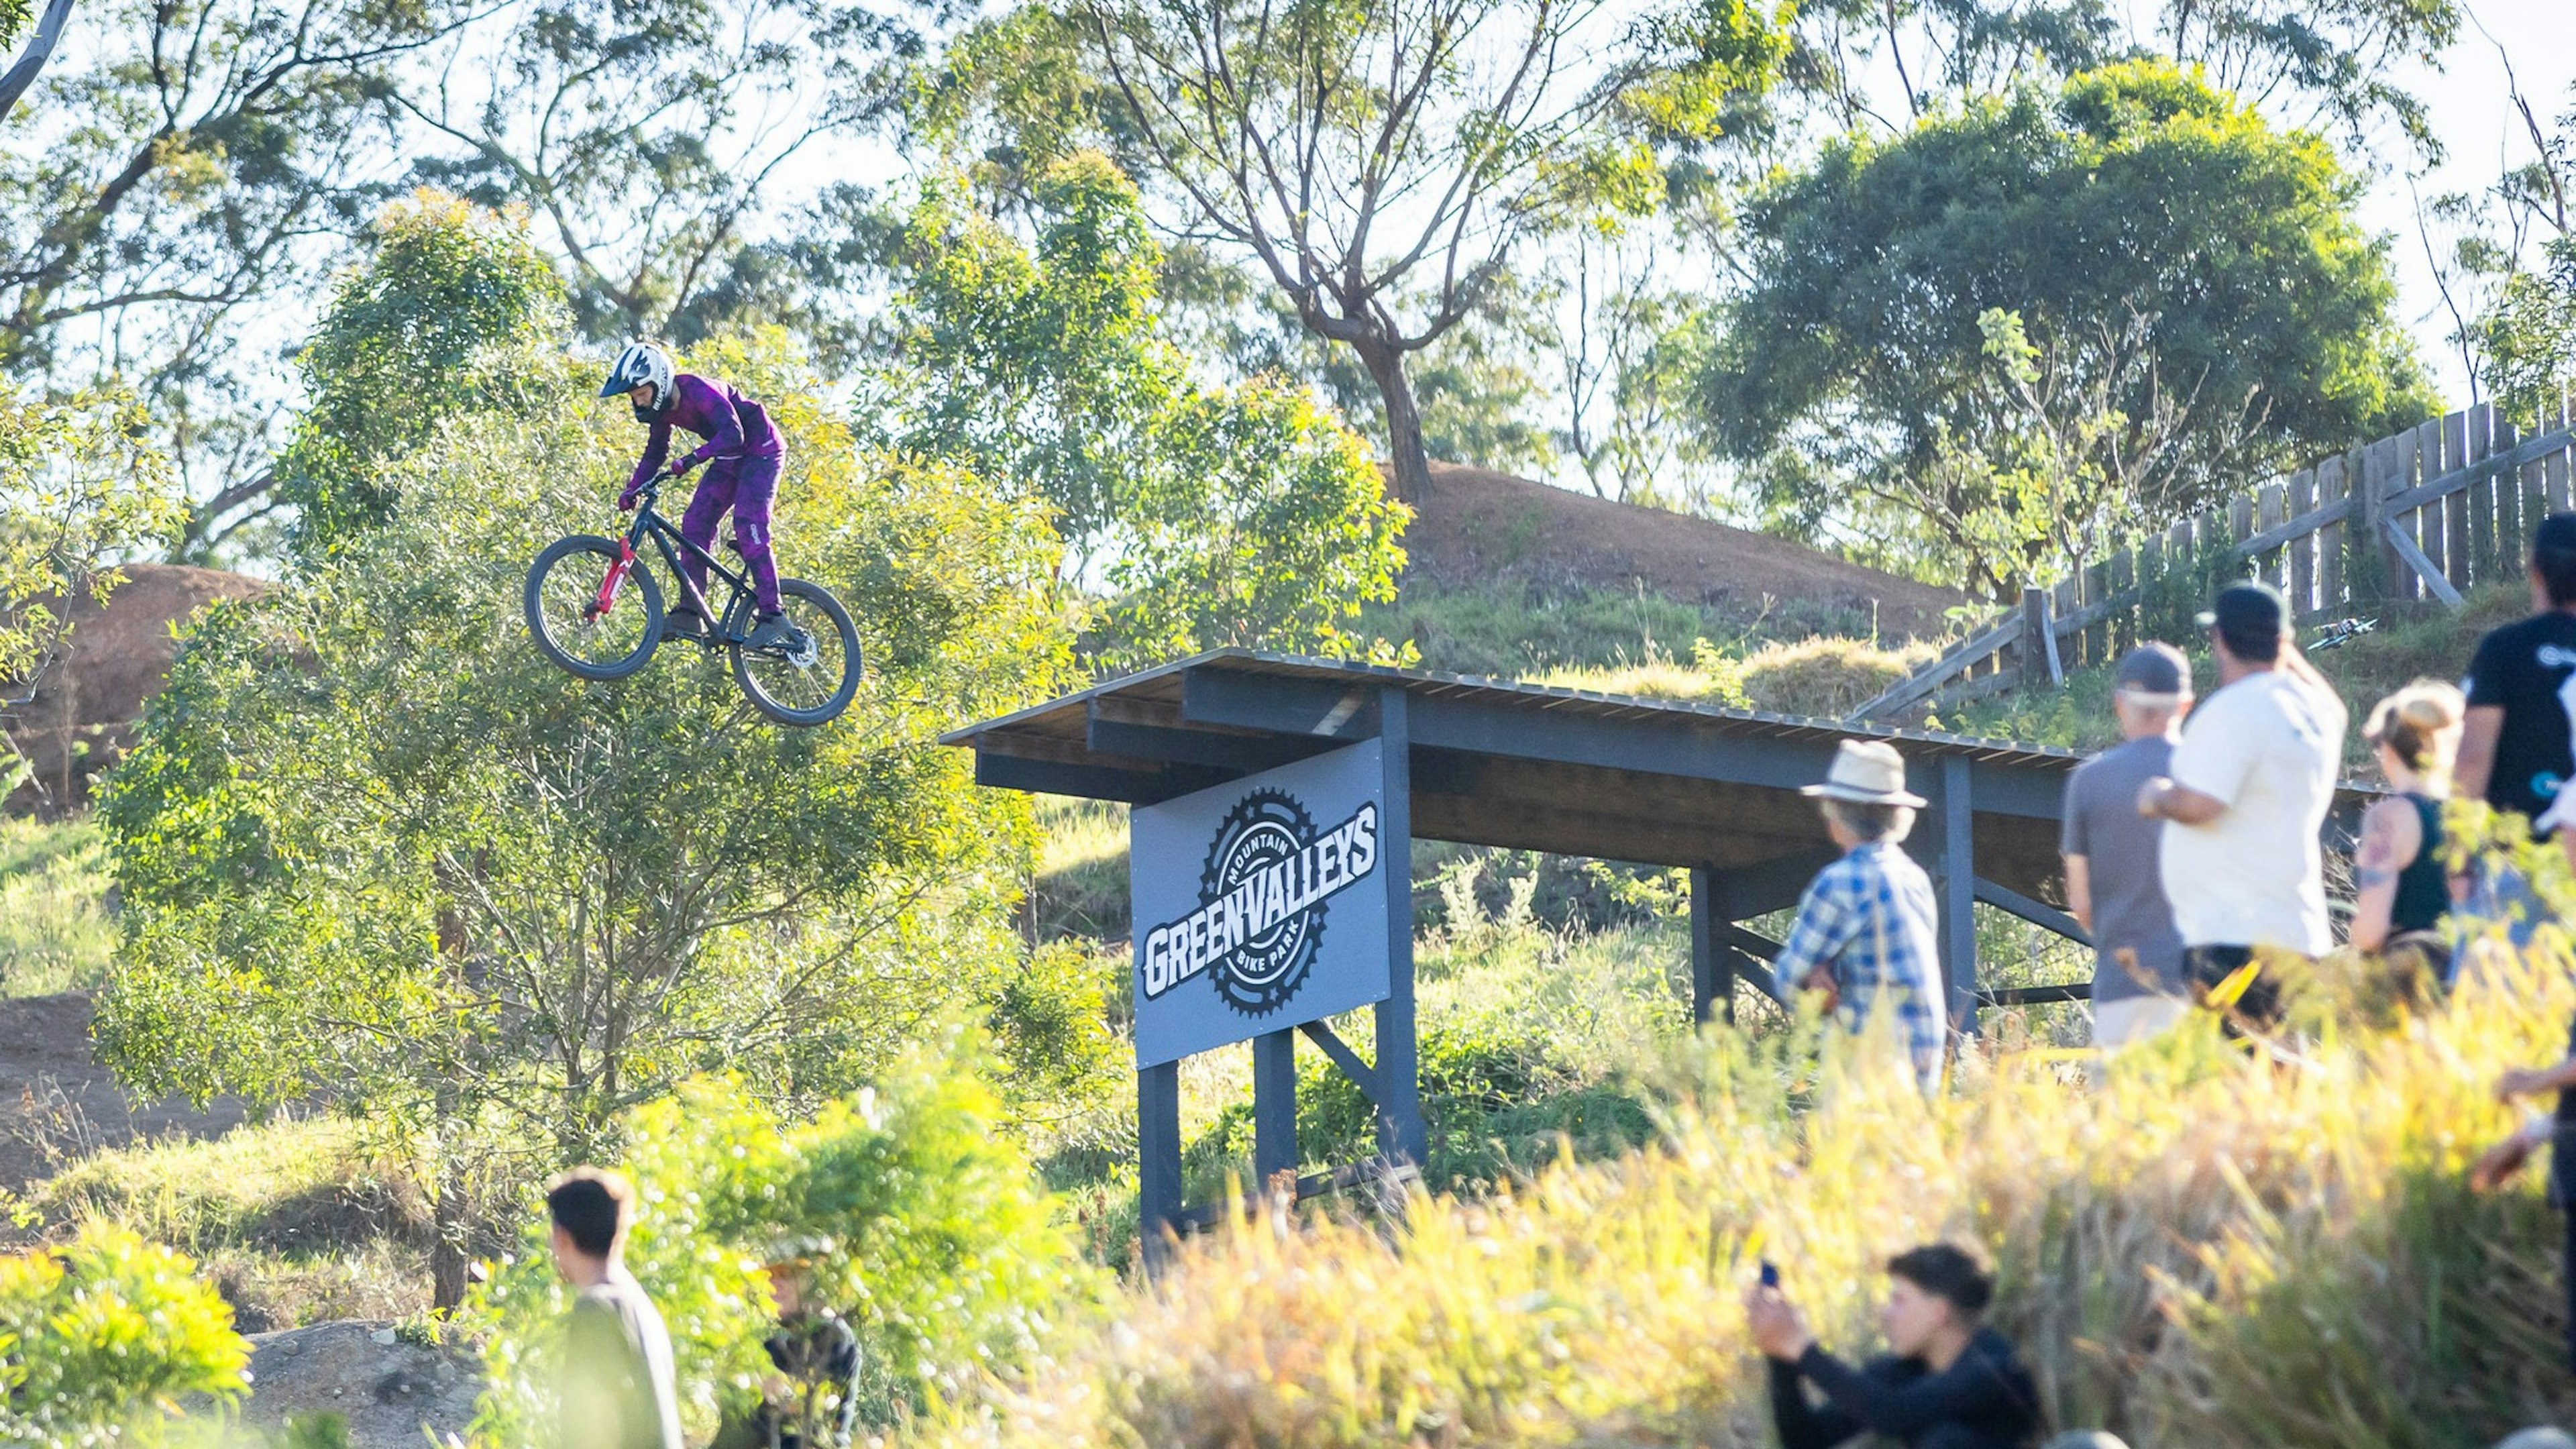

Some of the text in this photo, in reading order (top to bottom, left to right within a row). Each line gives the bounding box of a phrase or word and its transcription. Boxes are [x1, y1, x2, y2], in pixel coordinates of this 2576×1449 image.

[1228, 834, 1289, 885] MOUNTAIN
[1143, 805, 1377, 998] GREENVALLEYS
[1236, 919, 1299, 972] BIKE PARK
